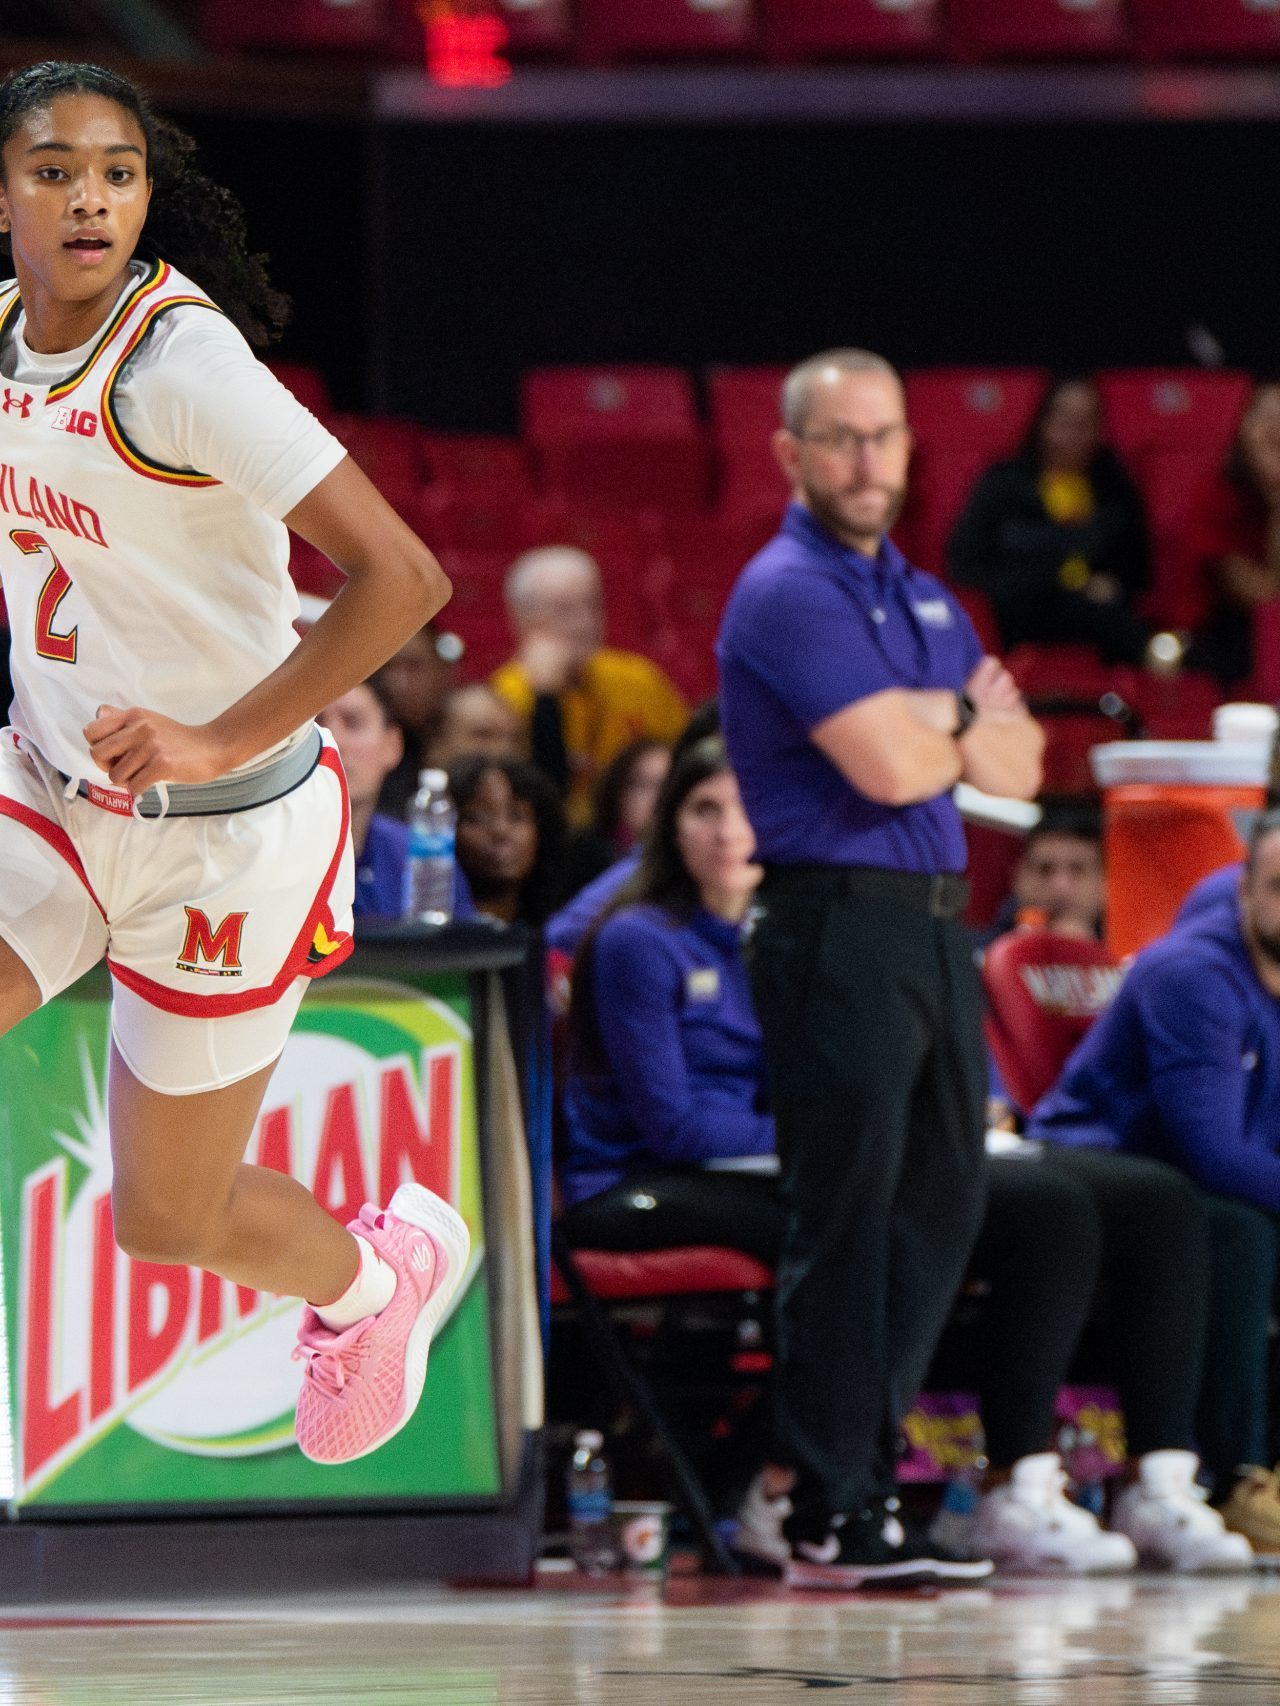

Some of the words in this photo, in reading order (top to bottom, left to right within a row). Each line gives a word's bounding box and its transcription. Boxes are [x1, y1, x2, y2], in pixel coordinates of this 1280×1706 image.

[9, 529, 79, 665] 2
[91, 789, 130, 810] MARYLAND
[177, 905, 249, 967] M
